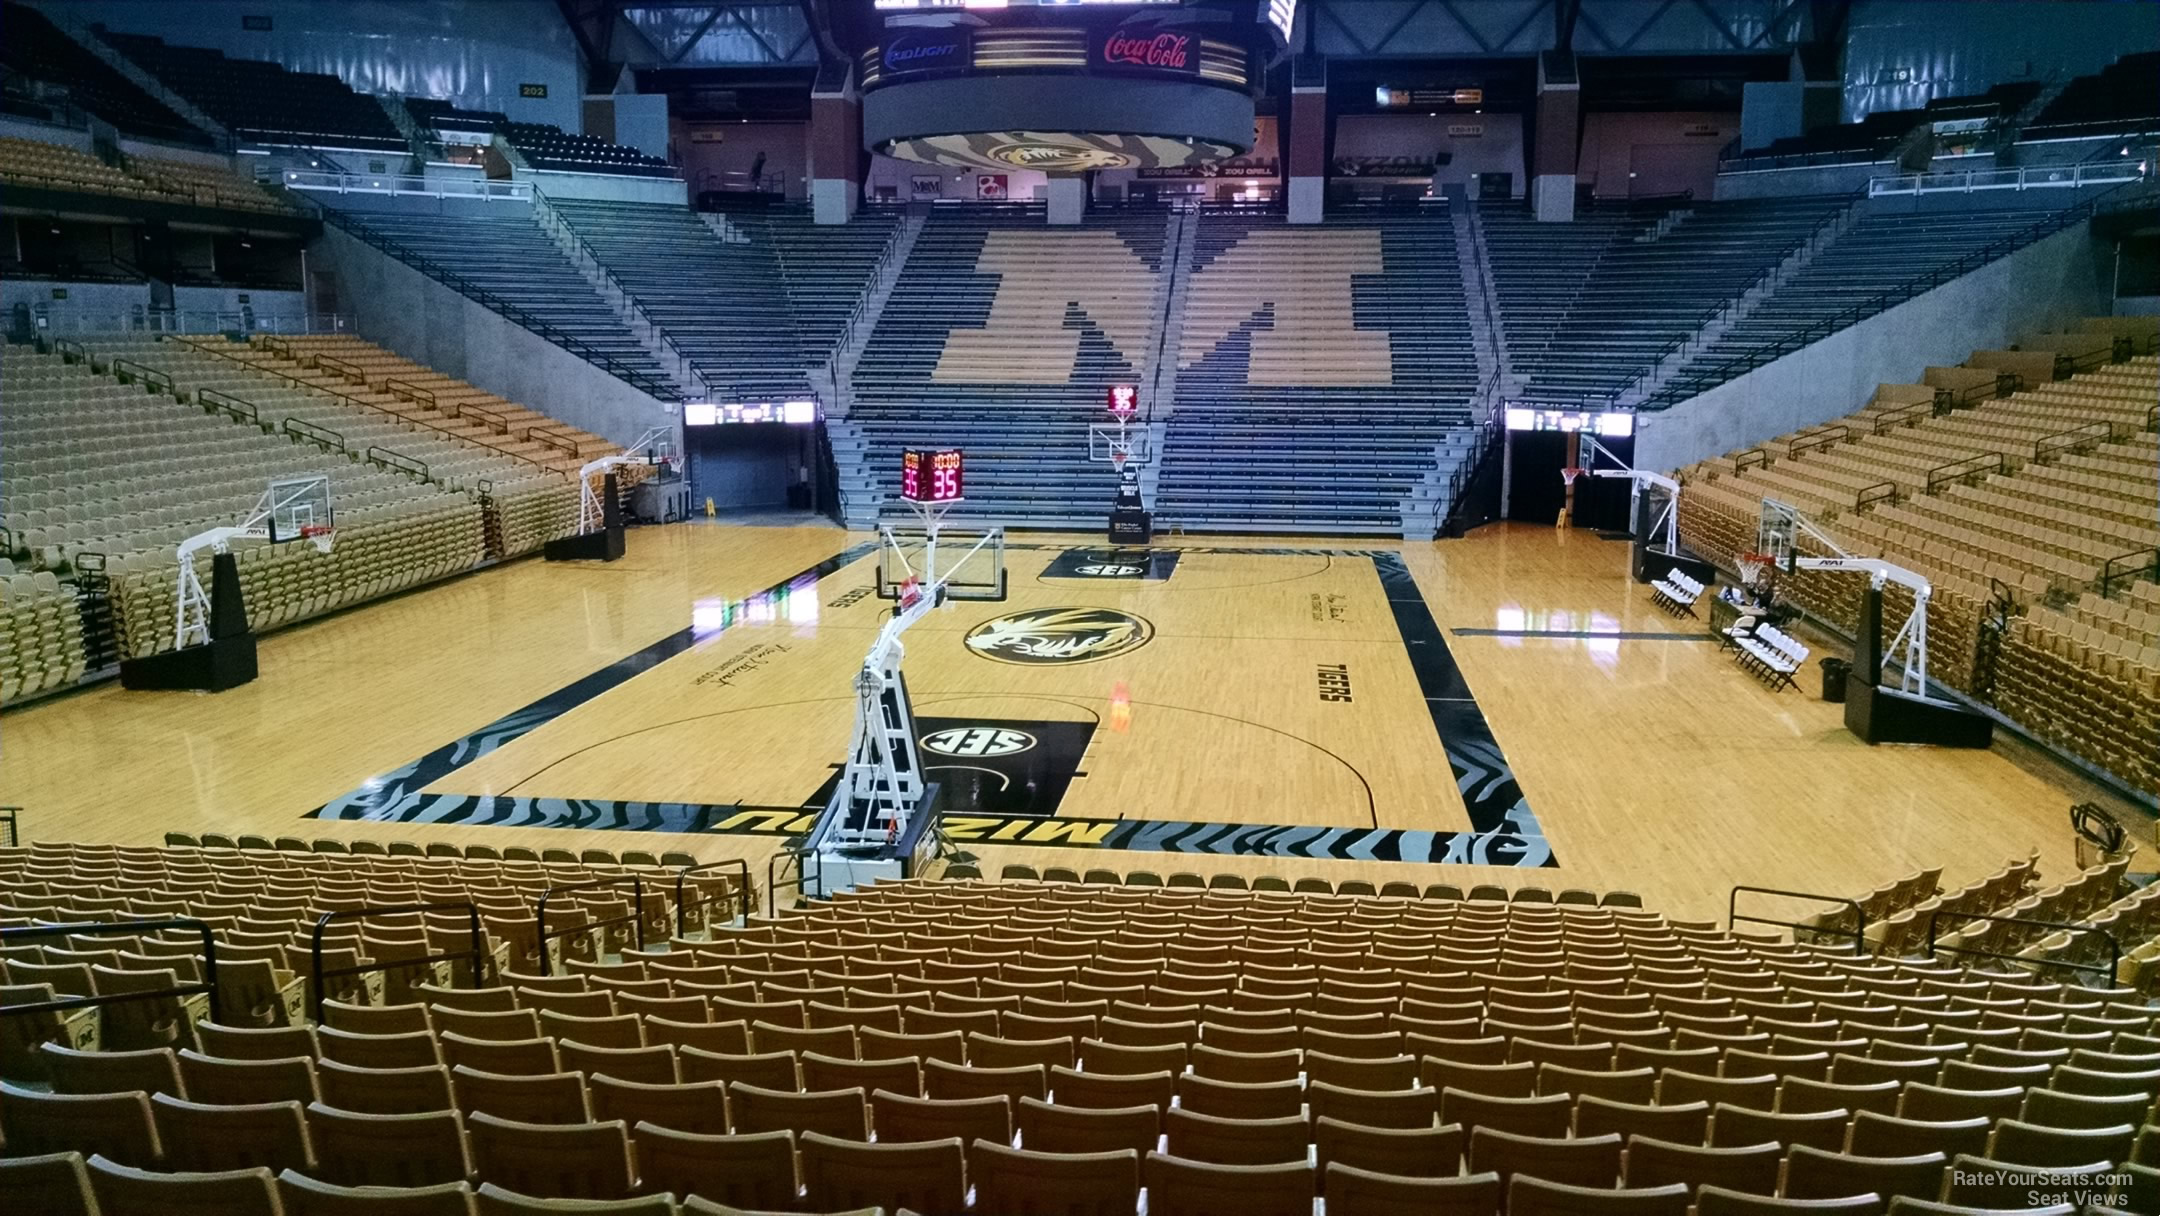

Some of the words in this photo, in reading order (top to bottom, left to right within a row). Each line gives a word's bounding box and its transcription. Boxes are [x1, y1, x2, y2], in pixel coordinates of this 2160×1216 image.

[912, 44, 959, 59] LIGHT
[1104, 30, 1190, 68] Coca-Cola
[523, 87, 544, 96] 202
[934, 453, 960, 470] 10:00
[905, 469, 918, 497] 35
[934, 469, 957, 498] 35
[1078, 564, 1142, 576] SEC
[1317, 663, 1354, 703] TIGERS
[927, 728, 1028, 756] SEC
